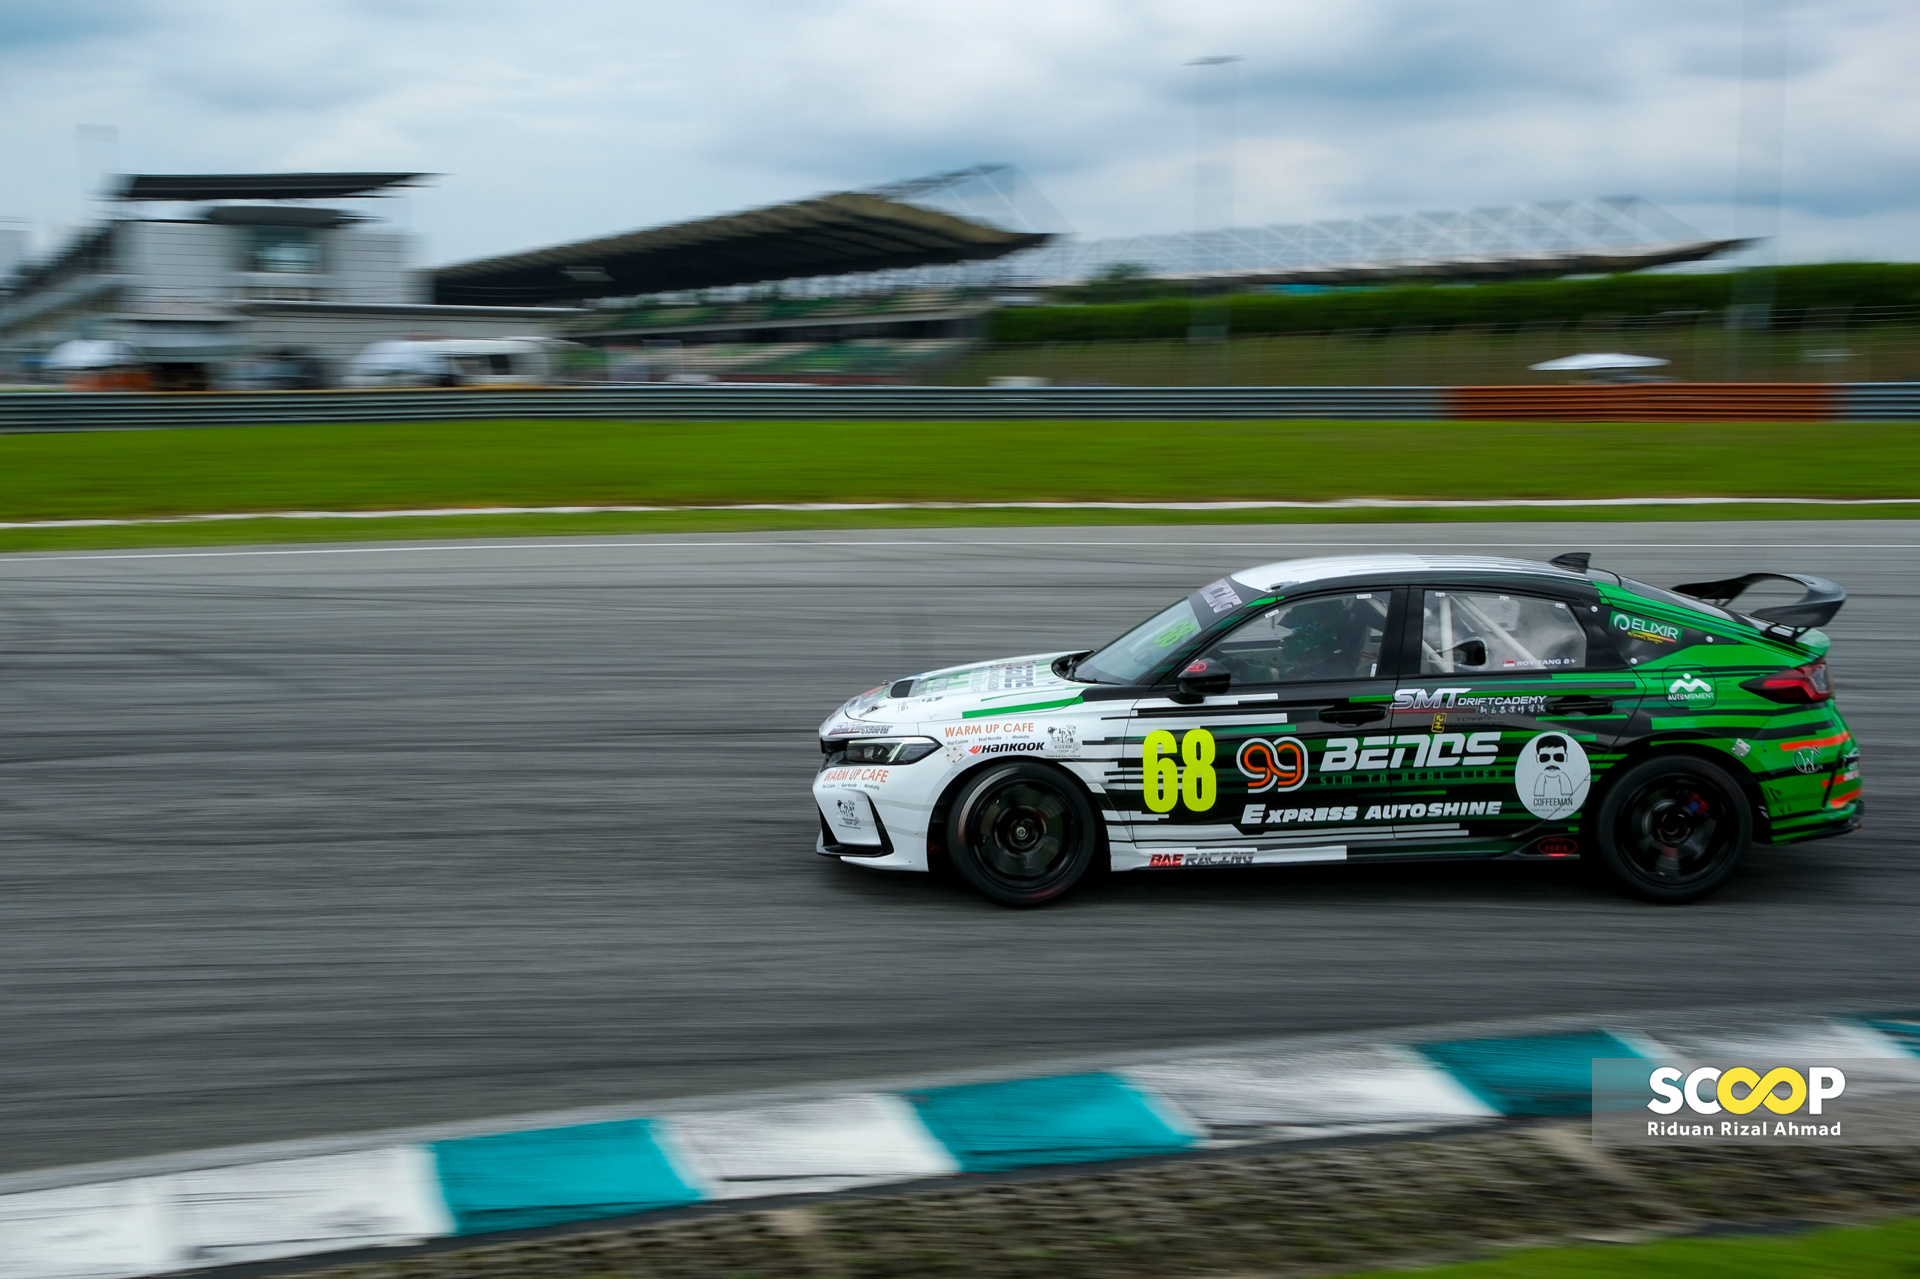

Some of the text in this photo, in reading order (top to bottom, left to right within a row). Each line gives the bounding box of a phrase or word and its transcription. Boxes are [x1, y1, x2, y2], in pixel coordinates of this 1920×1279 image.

[1631, 618, 1679, 640] ELIXIR
[1390, 688, 1547, 709] SMT DRIFTCADEMY
[1668, 692, 1714, 700] AUTOMOMENT
[945, 723, 1034, 738] WARM UP CAFE
[1142, 728, 1217, 813] 68
[1236, 736, 1308, 793] 99
[824, 768, 889, 783] WARM UP CAFE
[1320, 770, 1502, 786] SIM TO REAL LIFE
[1533, 798, 1573, 806] COFFEEMAN
[1241, 801, 1502, 825] EXPRESS AUTOSHINE
[1149, 852, 1255, 866] BAE RACING
